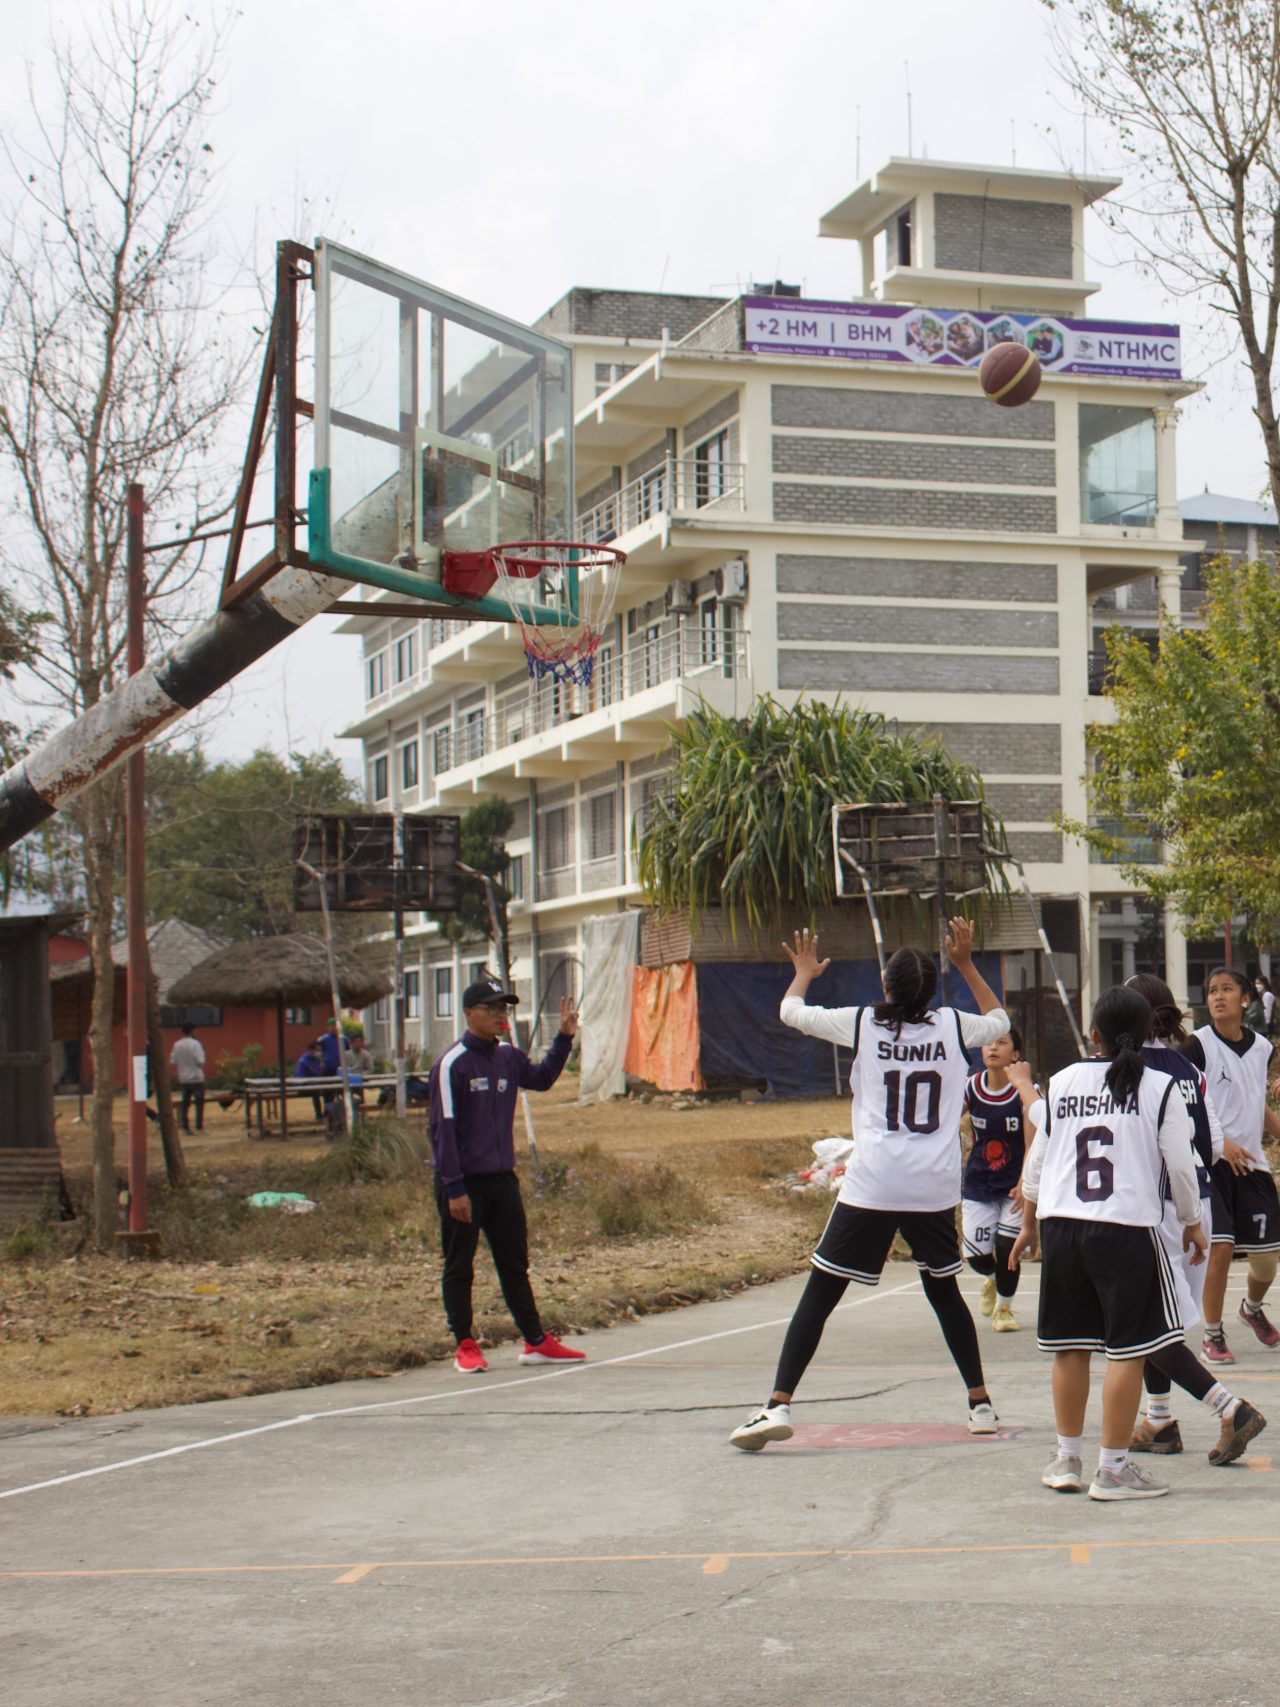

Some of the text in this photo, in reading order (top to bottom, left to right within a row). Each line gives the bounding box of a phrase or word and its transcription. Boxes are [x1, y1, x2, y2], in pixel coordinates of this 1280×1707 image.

[756, 318, 780, 336] +2
[787, 319, 818, 338] HM
[847, 324, 892, 343] BHM
[1099, 340, 1176, 362] NTHMC
[878, 1041, 947, 1062] SONIA
[884, 1070, 942, 1135] 10
[1057, 1090, 1140, 1119] GRISHMA
[1005, 1116, 1019, 1131] 13
[1075, 1126, 1114, 1203] 6
[976, 1226, 991, 1242] 05
[1252, 1213, 1267, 1239] 7
